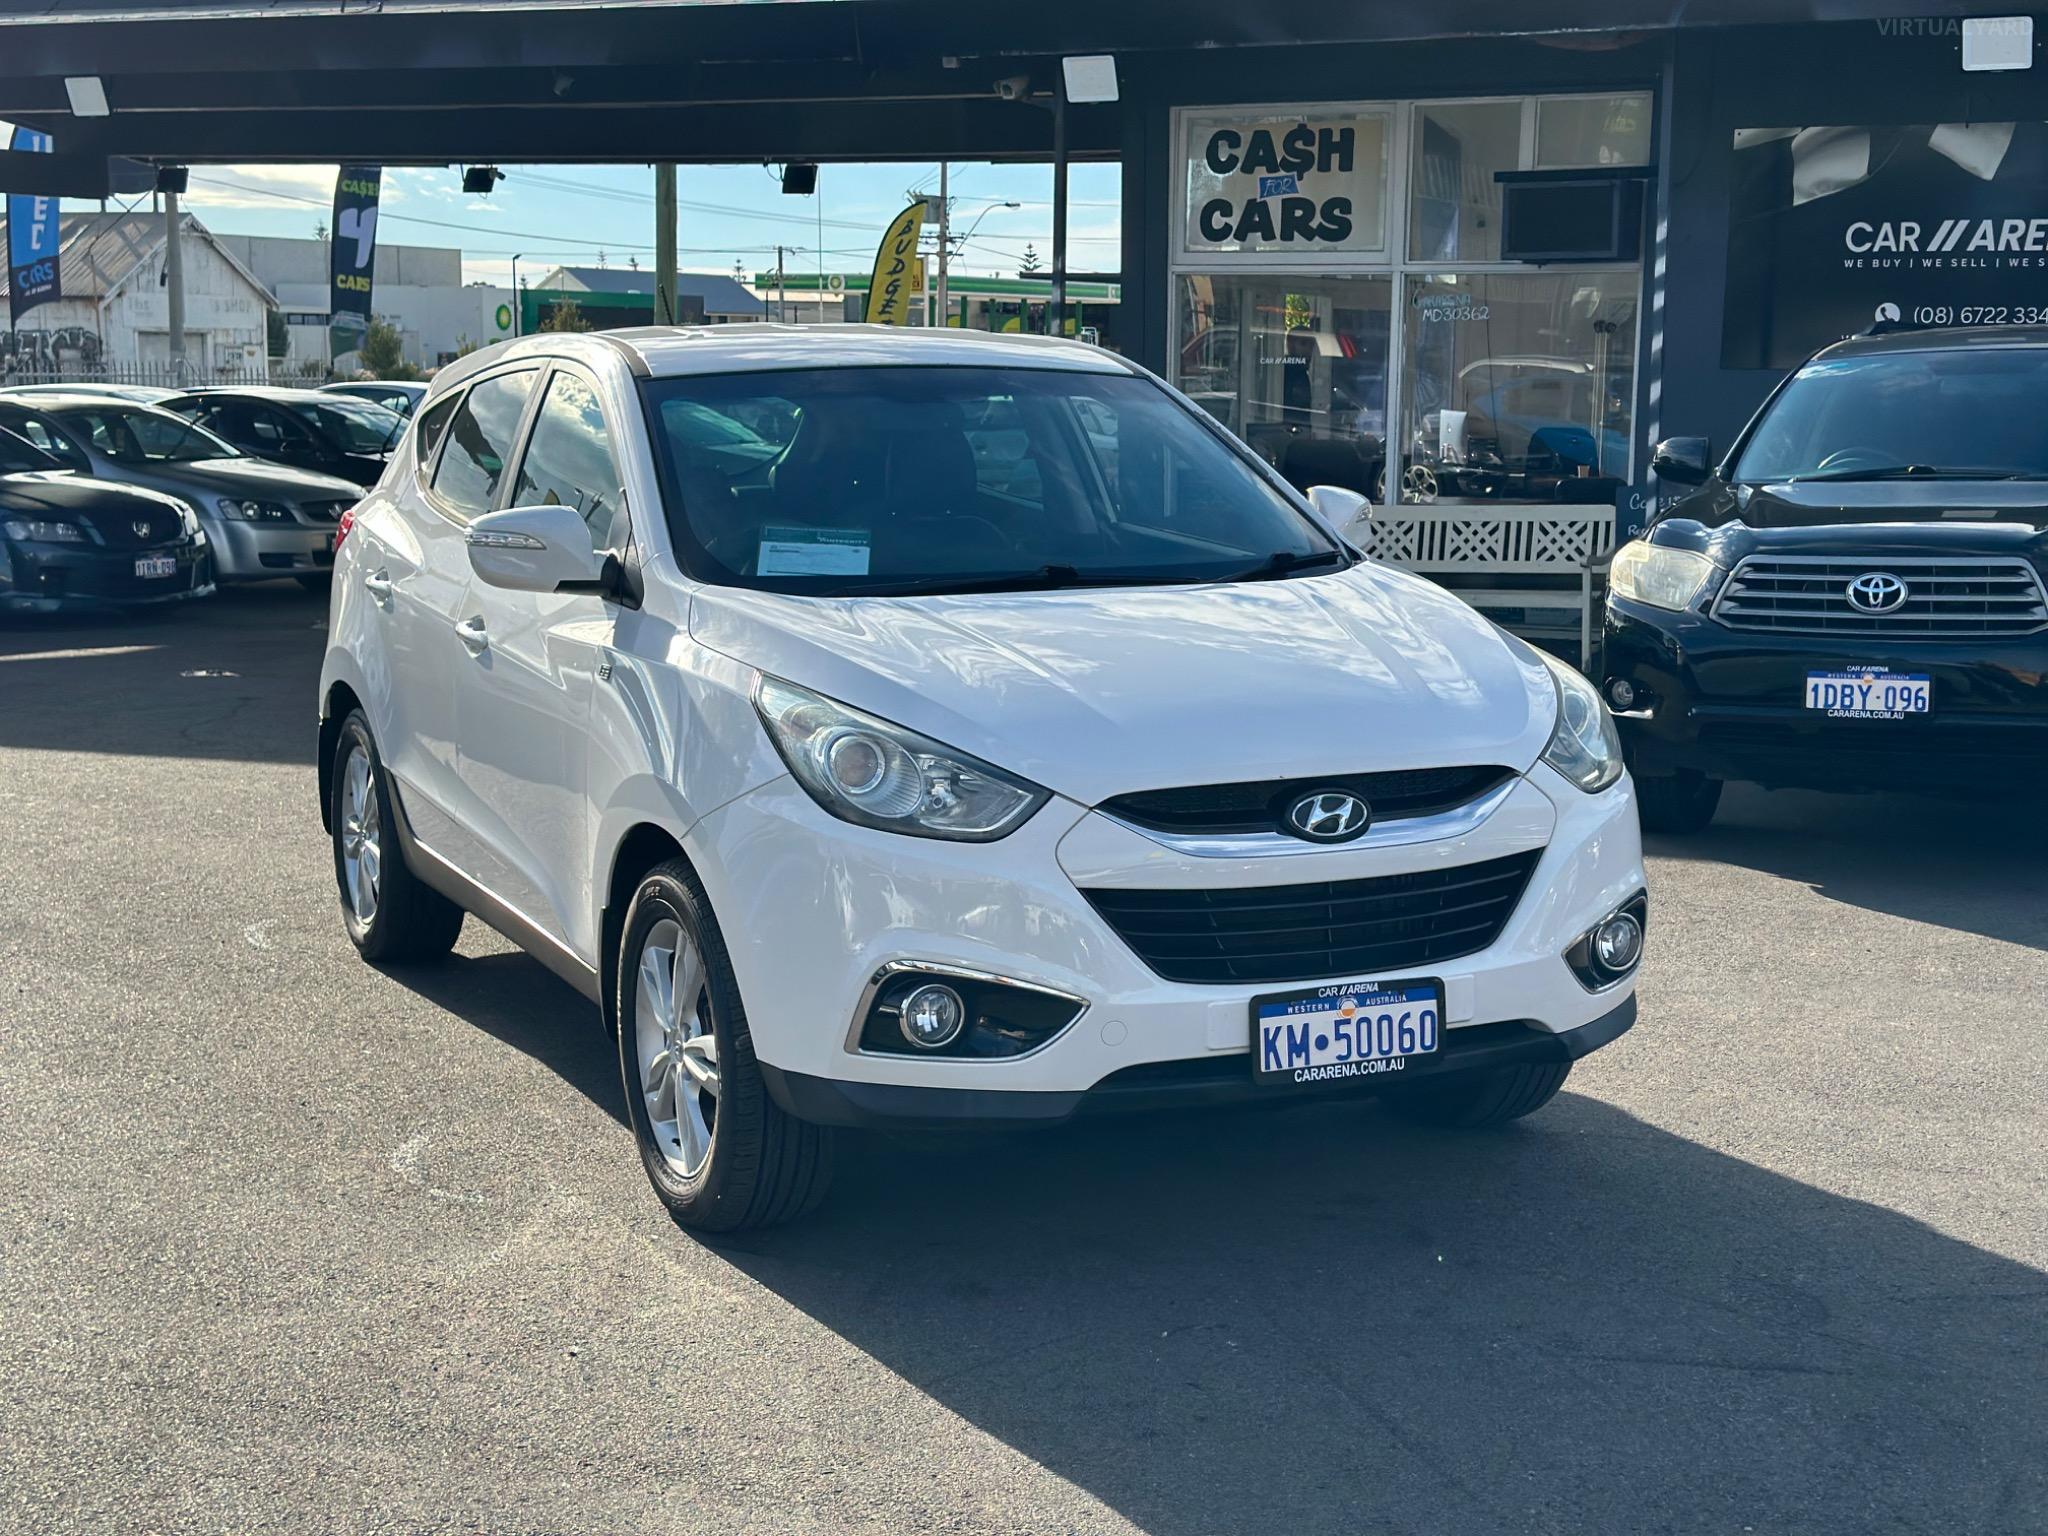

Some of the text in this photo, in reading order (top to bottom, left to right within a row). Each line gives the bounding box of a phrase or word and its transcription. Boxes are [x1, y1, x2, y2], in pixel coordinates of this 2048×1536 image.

[1206, 123, 1355, 181] CA$H
[1264, 178, 1293, 197] FOR
[1200, 197, 1353, 242] CARS
[338, 206, 378, 269] 4
[1966, 219, 2048, 252] ARE
[1844, 259, 1863, 268] WE
[1872, 259, 1902, 268] BUY
[1922, 259, 1942, 267] WE
[1951, 258, 1987, 267] SELL
[2009, 258, 2029, 267] WE
[1422, 306, 1490, 322] MD30362
[1913, 306, 1954, 325] (08)
[1960, 307, 2008, 324] 6722
[1827, 709, 1905, 720] CARARENA.COM.AU
[1287, 994, 1407, 1015] WESTERN AUSTRALIA
[1294, 1057, 1406, 1083] CARARENA.COM.AU
